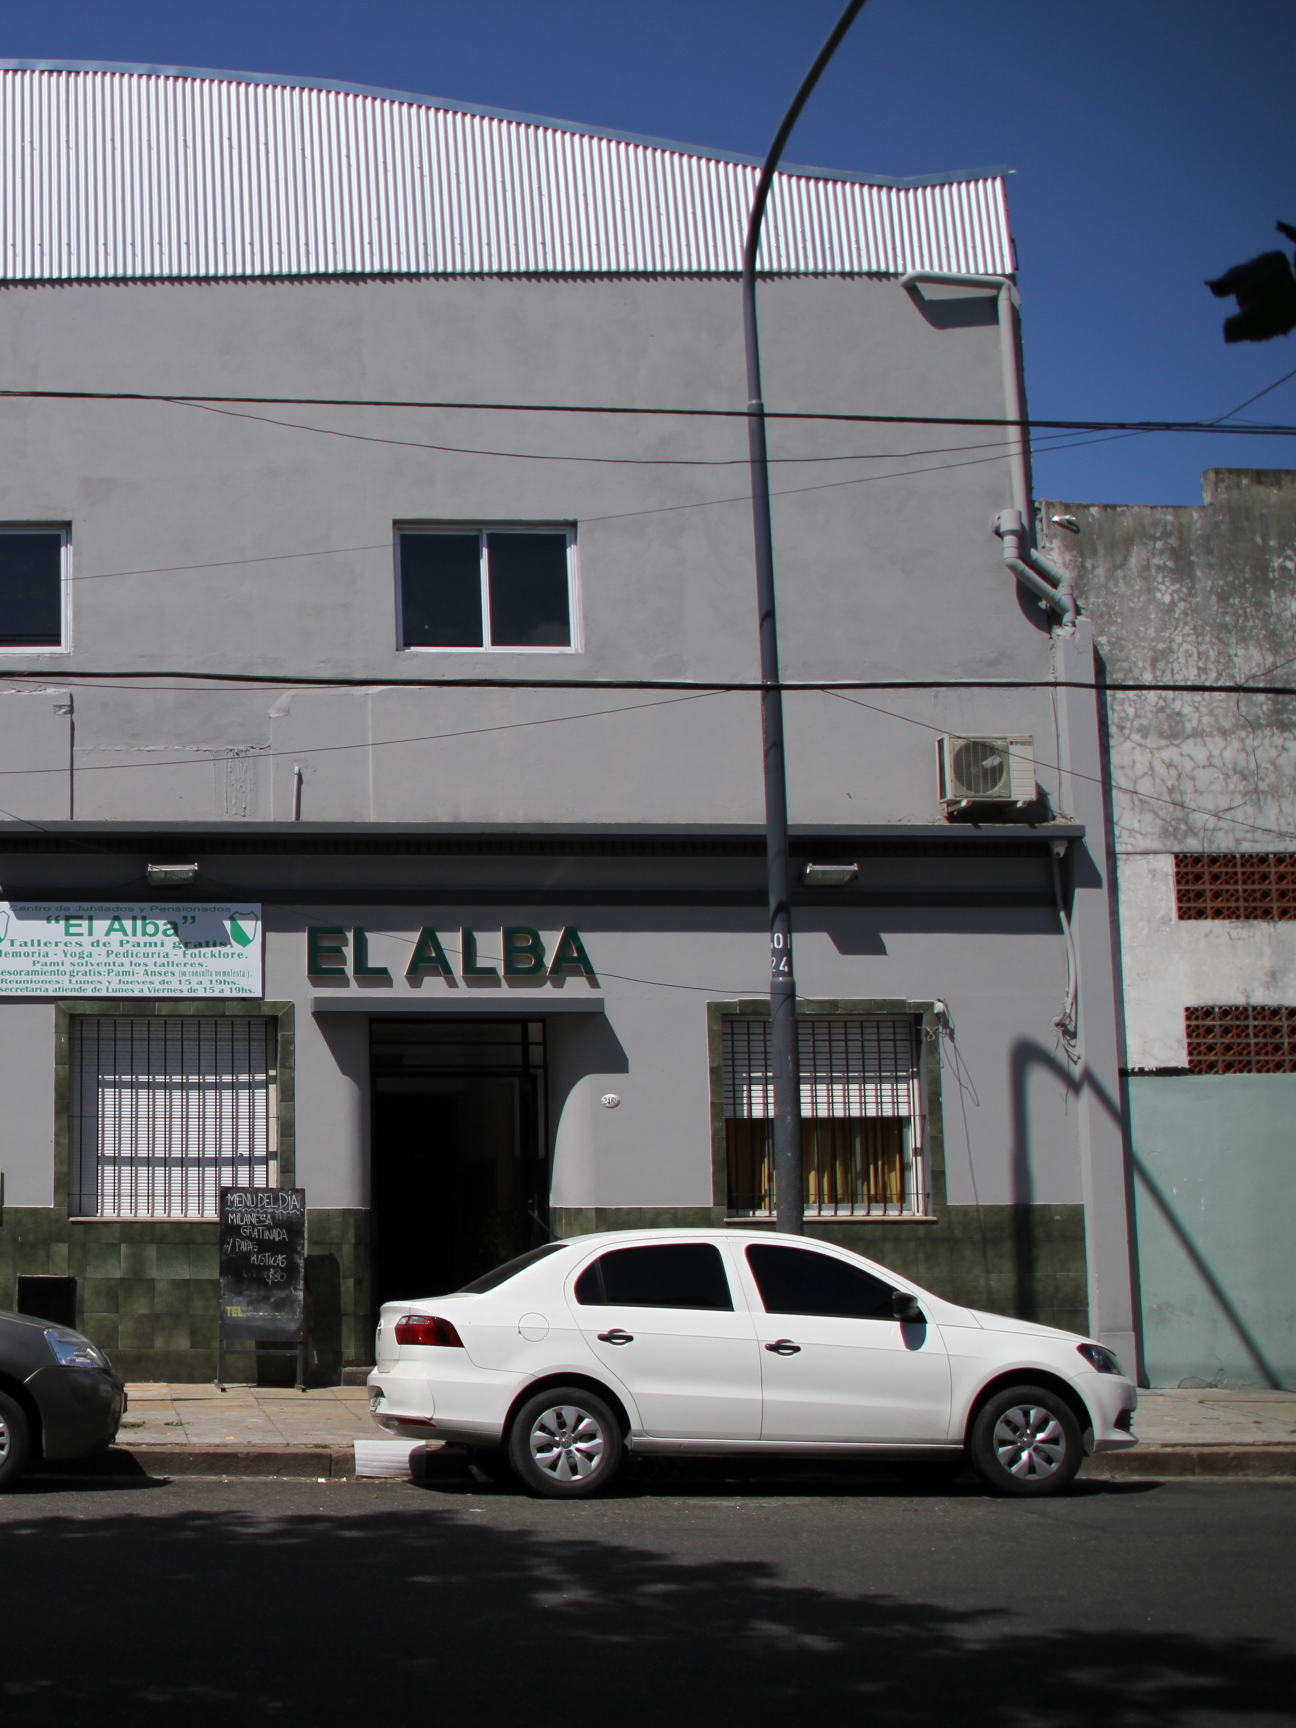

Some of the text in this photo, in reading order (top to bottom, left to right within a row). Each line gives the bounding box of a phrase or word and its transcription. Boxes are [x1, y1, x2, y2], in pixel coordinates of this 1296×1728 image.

[139, 905, 145, 914] y
[150, 905, 232, 913] Pensionados
[7, 939, 233, 950] Talleres de Pami gratis.
[62, 950, 93, 961] Yoga
[183, 949, 248, 960] Folcklore.
[306, 926, 596, 977] EL ALBA
[70, 960, 124, 968] solventa
[143, 969, 175, 977] Anses
[52, 986, 87, 994] atiende
[91, 986, 102, 994] de
[106, 986, 135, 994] Lunes
[148, 986, 184, 994] Viernes
[226, 1192, 256, 1208] MENU
[258, 1193, 278, 1208] DEL
[228, 1213, 273, 1226] MILANESA
[240, 1226, 288, 1242] GRATINADA
[236, 1239, 259, 1252] PAPAS
